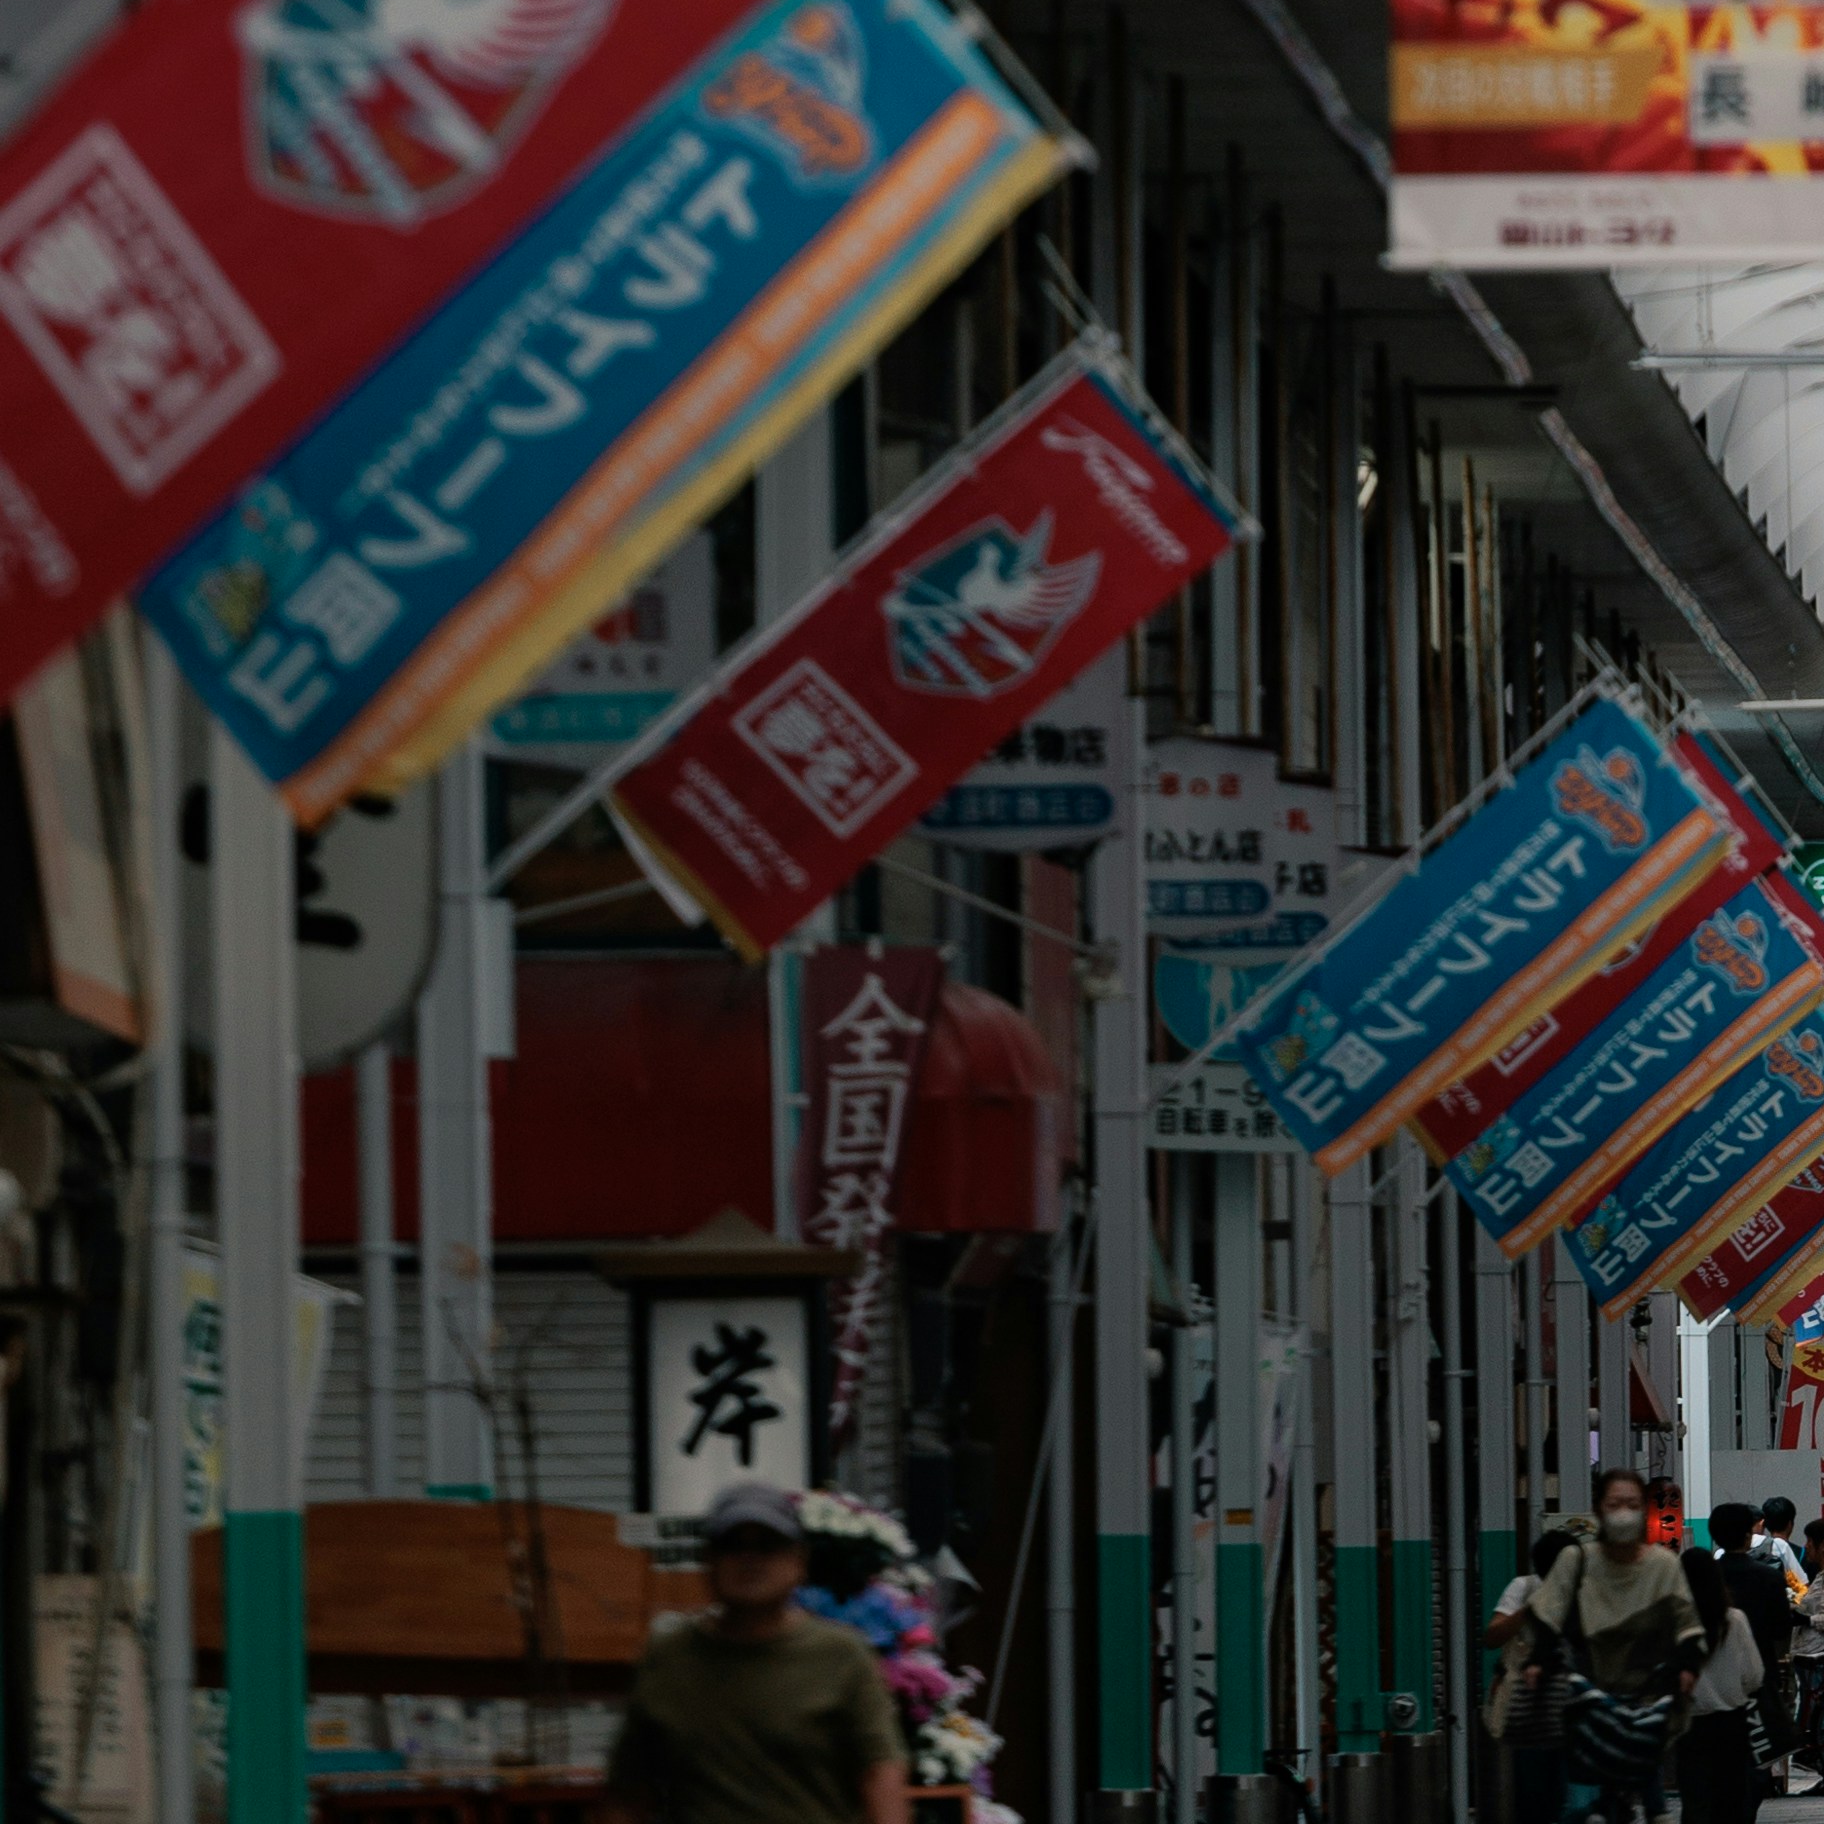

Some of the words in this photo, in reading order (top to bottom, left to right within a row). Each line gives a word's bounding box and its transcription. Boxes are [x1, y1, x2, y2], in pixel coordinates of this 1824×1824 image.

[1283, 835, 1587, 1125] トライフープ岡山
[1475, 979, 1718, 1216] トライフープ岡山
[1590, 1088, 1786, 1287] トライフープ岡山
[682, 1322, 785, 1465] 岸
